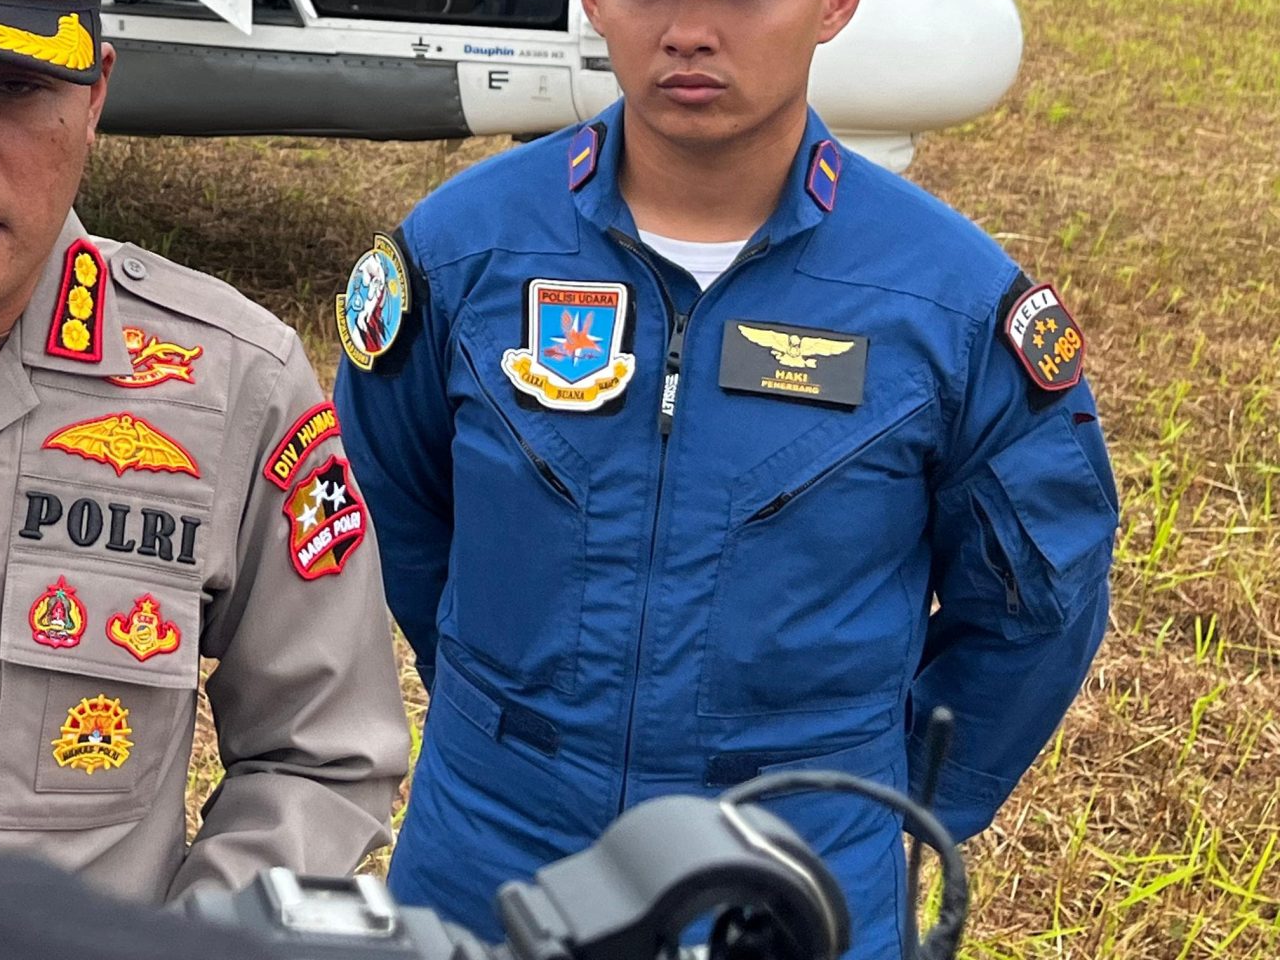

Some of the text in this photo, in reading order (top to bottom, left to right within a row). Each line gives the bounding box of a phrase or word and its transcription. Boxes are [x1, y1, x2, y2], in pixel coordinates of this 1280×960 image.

[463, 44, 515, 56] Dauphin
[542, 291, 615, 305] POLISI UDARA
[1014, 292, 1048, 335] HELI
[775, 369, 808, 383] HAKI
[556, 390, 585, 400] BUANA
[761, 380, 820, 394] PENERBANG
[662, 383, 677, 416] SISLEY
[274, 409, 336, 479] DIV HUMAS
[18, 491, 202, 565] POLRI
[333, 511, 361, 537] POLRI
